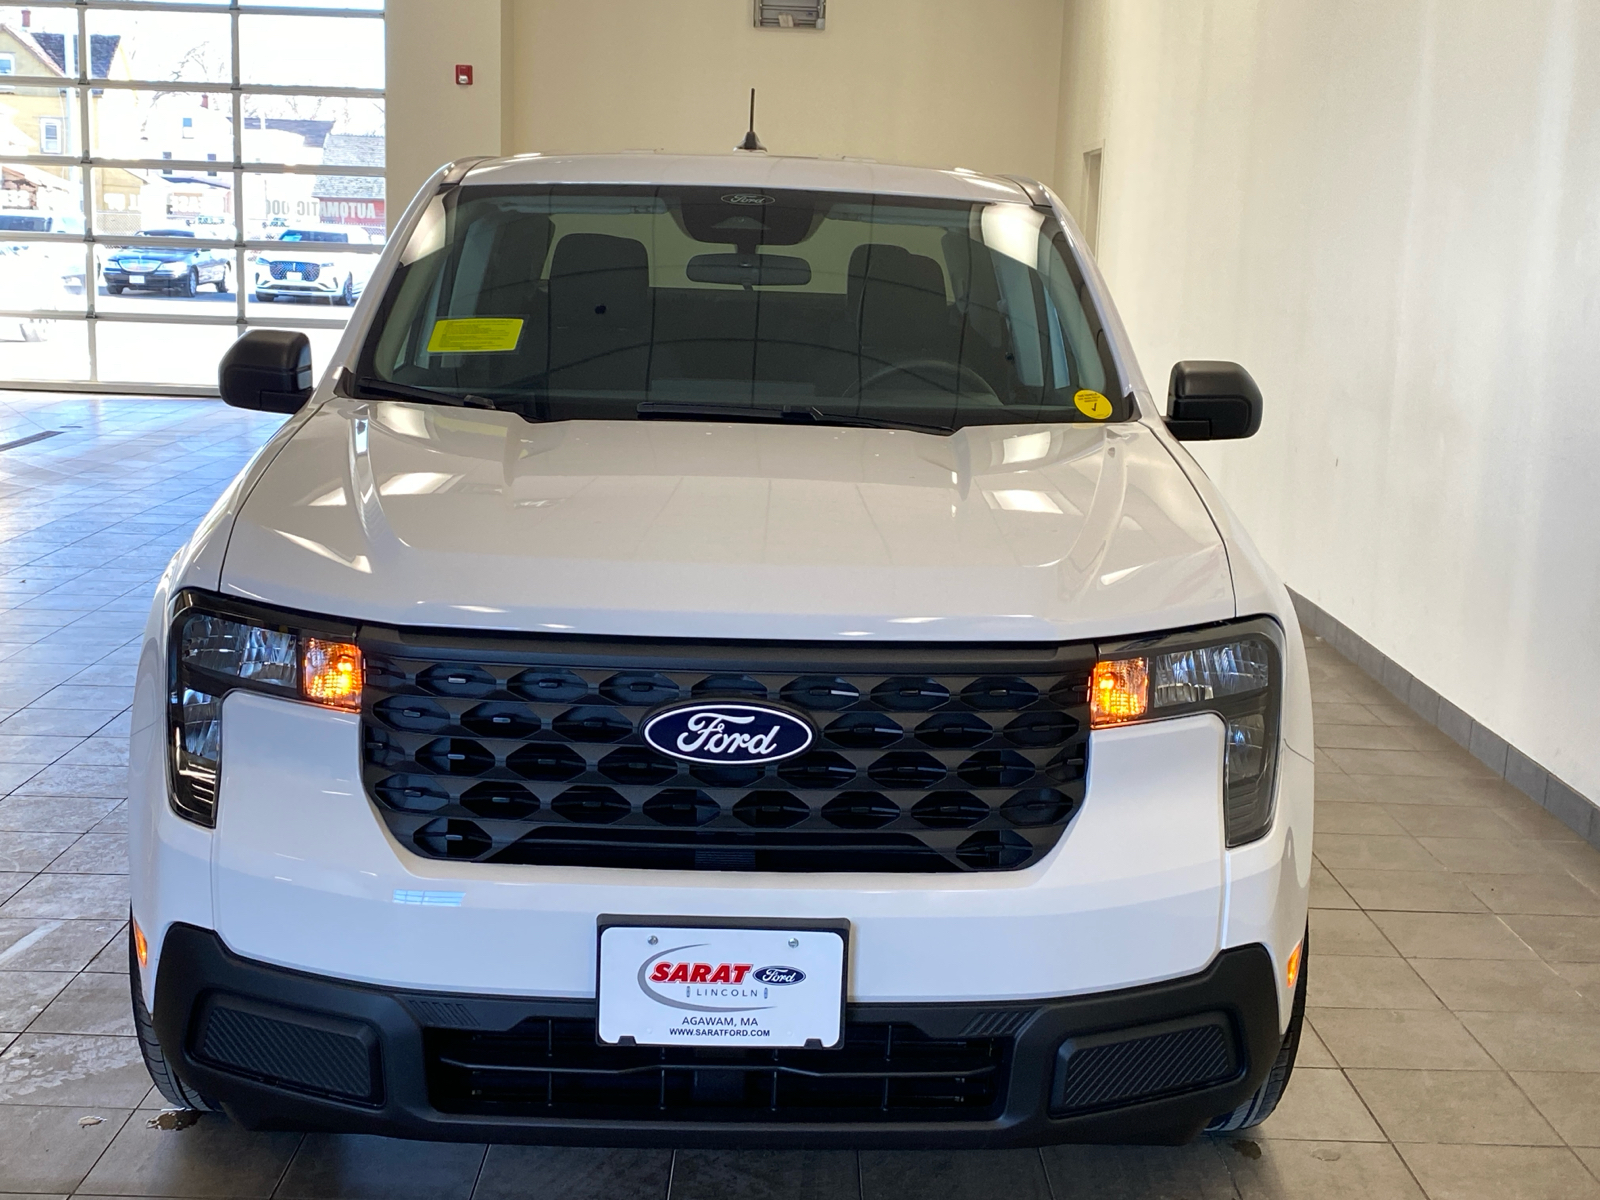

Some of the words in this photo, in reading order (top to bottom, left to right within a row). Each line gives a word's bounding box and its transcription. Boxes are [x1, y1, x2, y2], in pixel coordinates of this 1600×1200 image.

[730, 194, 766, 204] Ford
[676, 712, 781, 755] Ford
[649, 961, 754, 985] SARAT
[762, 968, 796, 983] Ford
[696, 987, 759, 998] LINCOLN
[681, 1016, 737, 1027] AGAWAM,
[740, 1017, 759, 1027] MA
[669, 1028, 771, 1038] WWW.SARATFORD.COM
